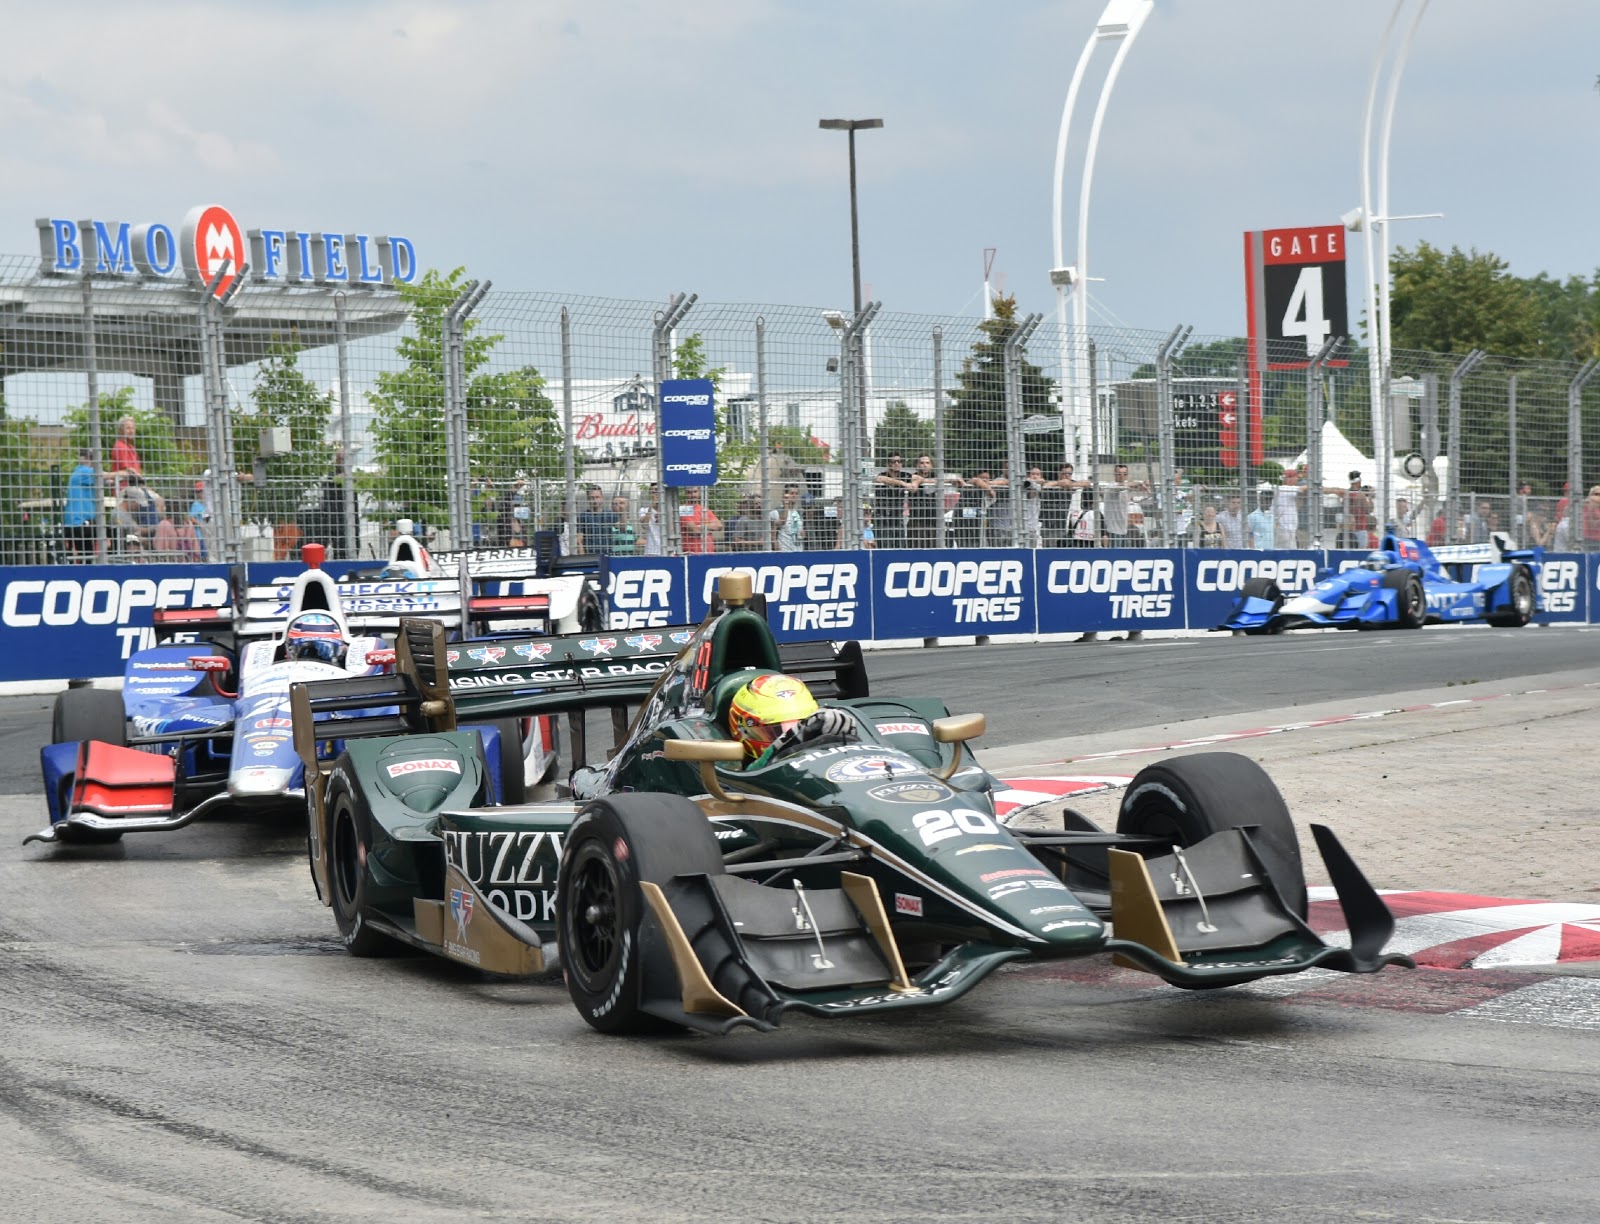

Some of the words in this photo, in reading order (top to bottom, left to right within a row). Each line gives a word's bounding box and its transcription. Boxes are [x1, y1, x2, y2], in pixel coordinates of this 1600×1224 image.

[51, 218, 177, 277] BMO
[260, 229, 418, 284] FIELD
[1270, 233, 1337, 257] GATE
[1281, 266, 1332, 357] 4
[663, 394, 709, 402] COOPER
[665, 428, 711, 436] COOPER
[1174, 415, 1197, 428] kets
[666, 463, 712, 471] COOPER
[884, 560, 1023, 598] COOPER
[1048, 559, 1174, 594] COOPER
[1197, 559, 1316, 592] COOPER
[2, 577, 229, 627] COOPER
[779, 602, 855, 631] TIRES
[952, 596, 1022, 622] TIRES
[1109, 594, 1172, 619] TIRES
[128, 675, 196, 684] Panasonic
[449, 673, 525, 690] ISING
[531, 666, 604, 682] STAR
[608, 661, 669, 676] RAC
[877, 724, 923, 734] ONAX
[390, 759, 457, 776] SONAX
[912, 808, 999, 847] 20
[442, 830, 565, 885] FUZZY
[479, 889, 557, 921] ODK
